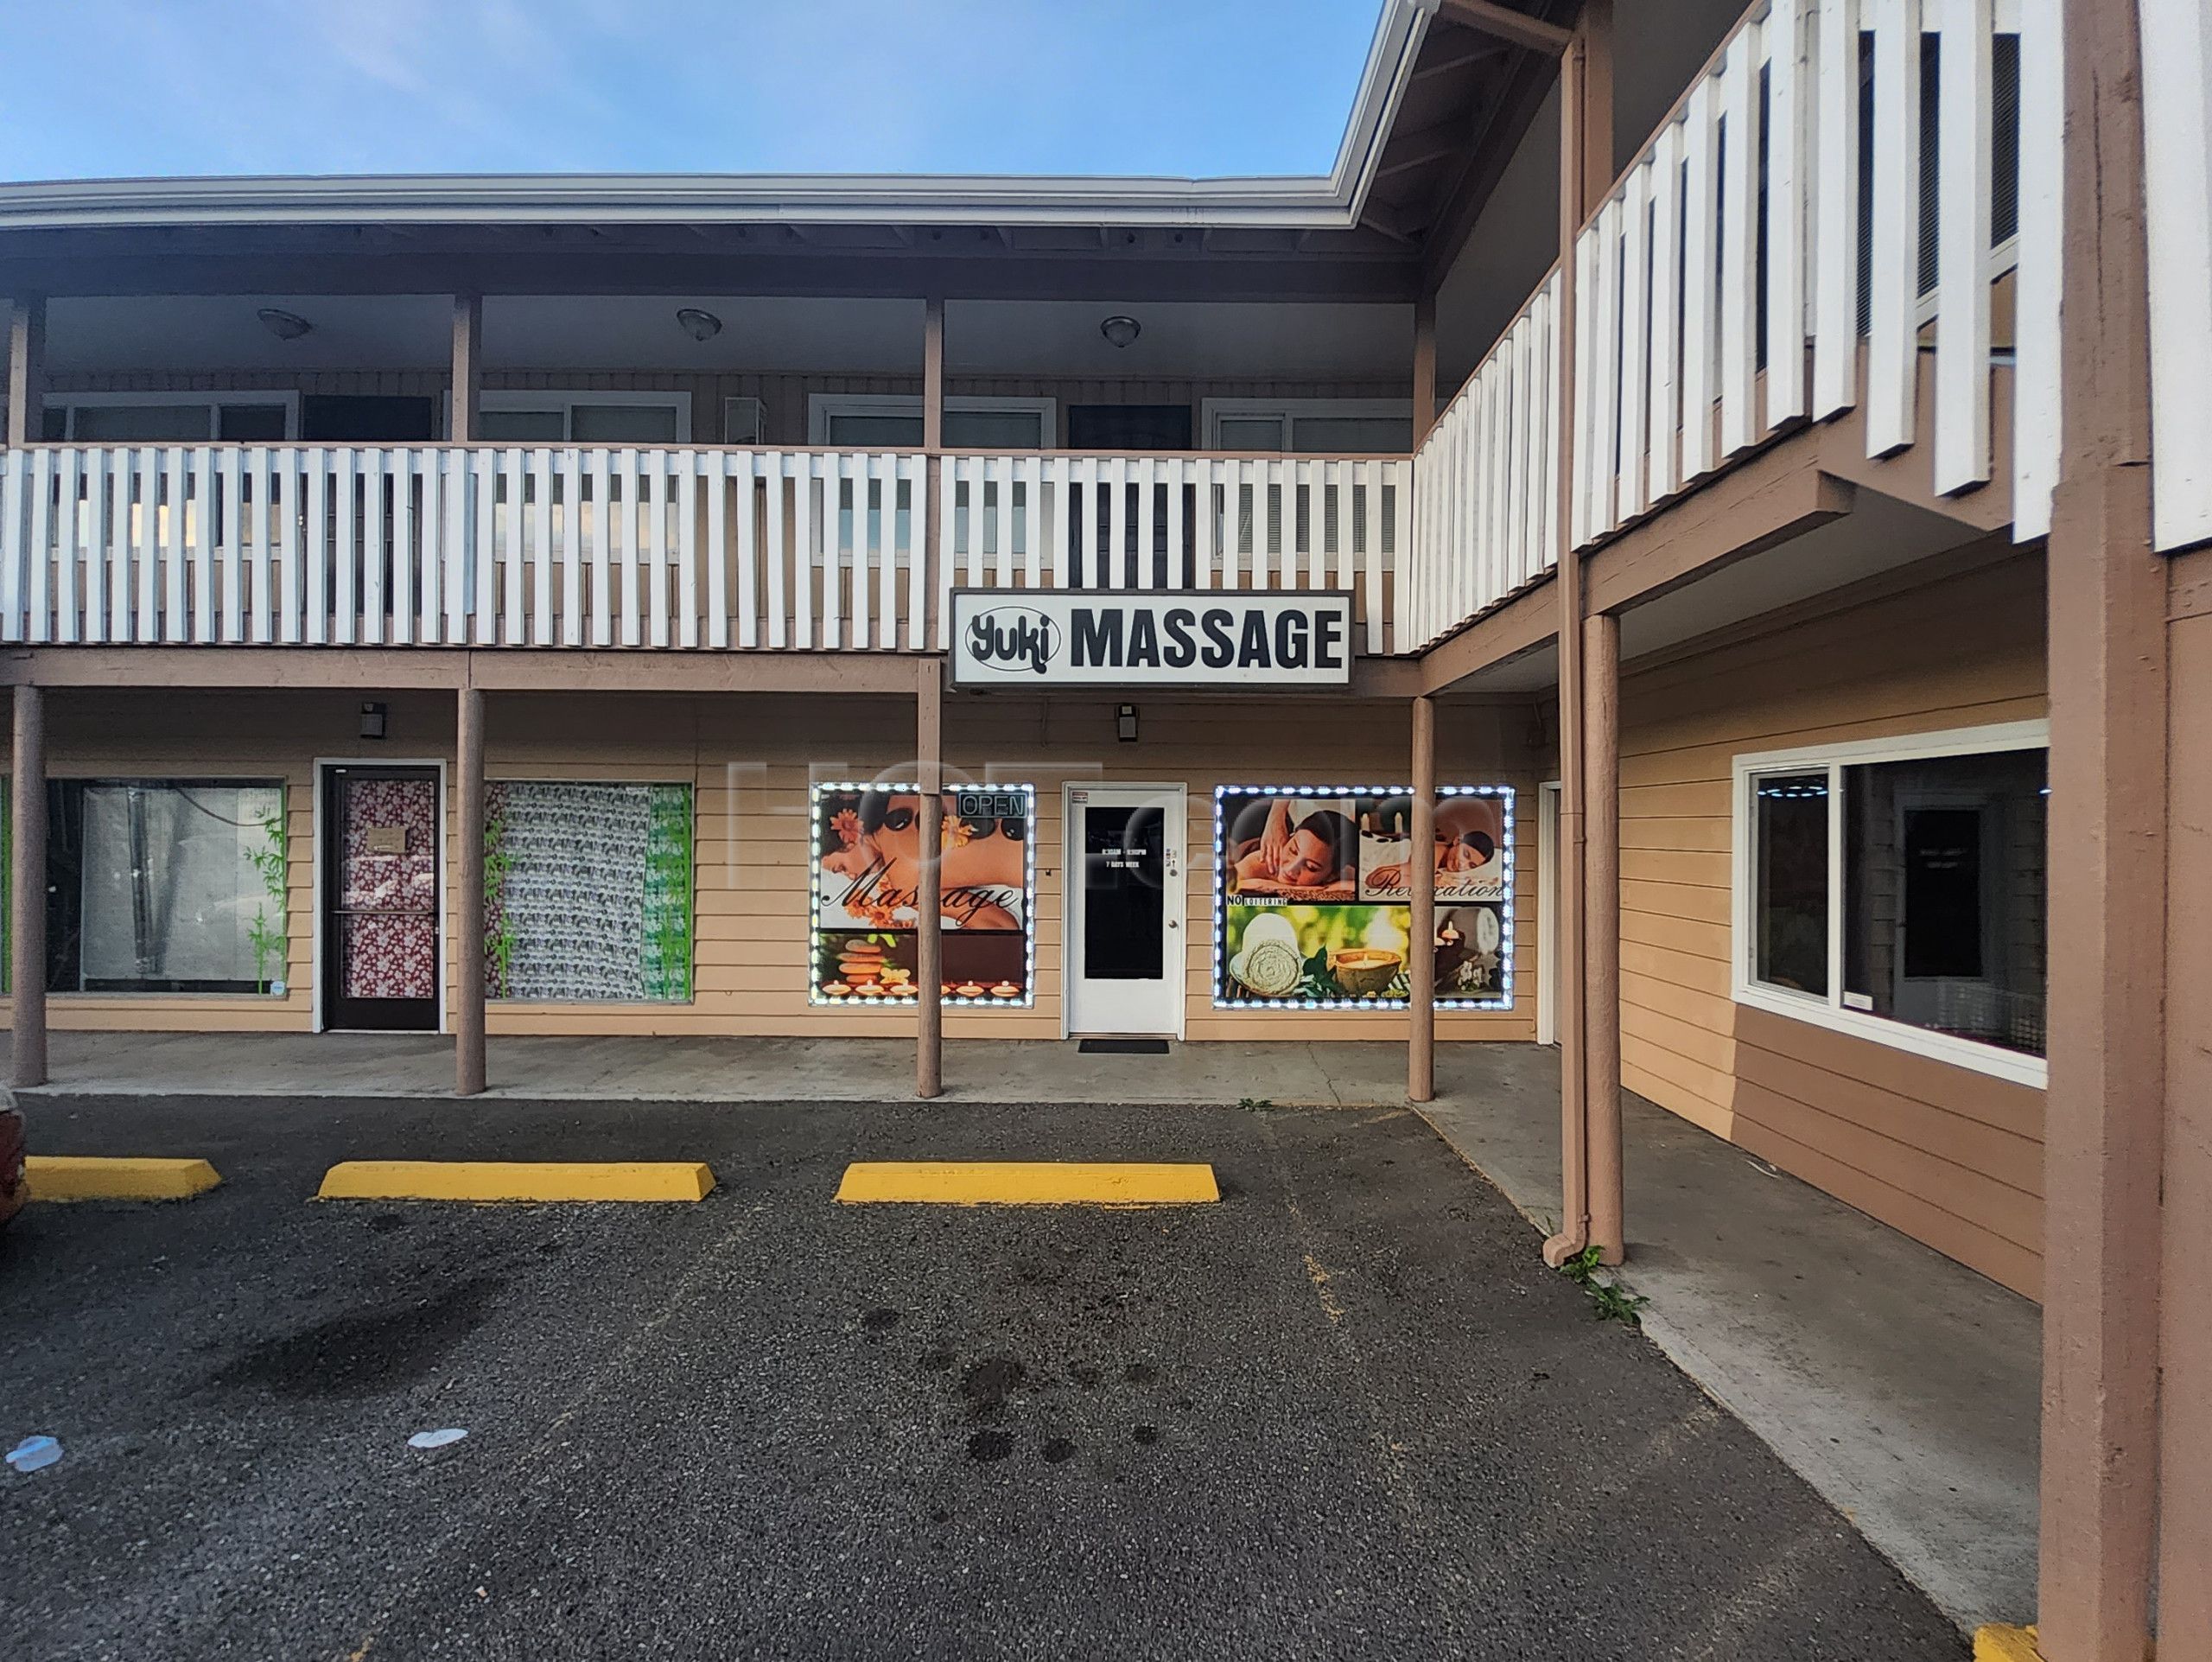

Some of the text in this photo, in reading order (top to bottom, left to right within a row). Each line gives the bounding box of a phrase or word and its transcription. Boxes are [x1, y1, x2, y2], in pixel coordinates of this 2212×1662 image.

[972, 608, 1343, 674] Yuki MASSAGE
[963, 795, 1024, 815] OPEN
[822, 856, 1019, 927] Masage
[1365, 868, 1503, 897] Rexation
[1227, 895, 1242, 906] NO
